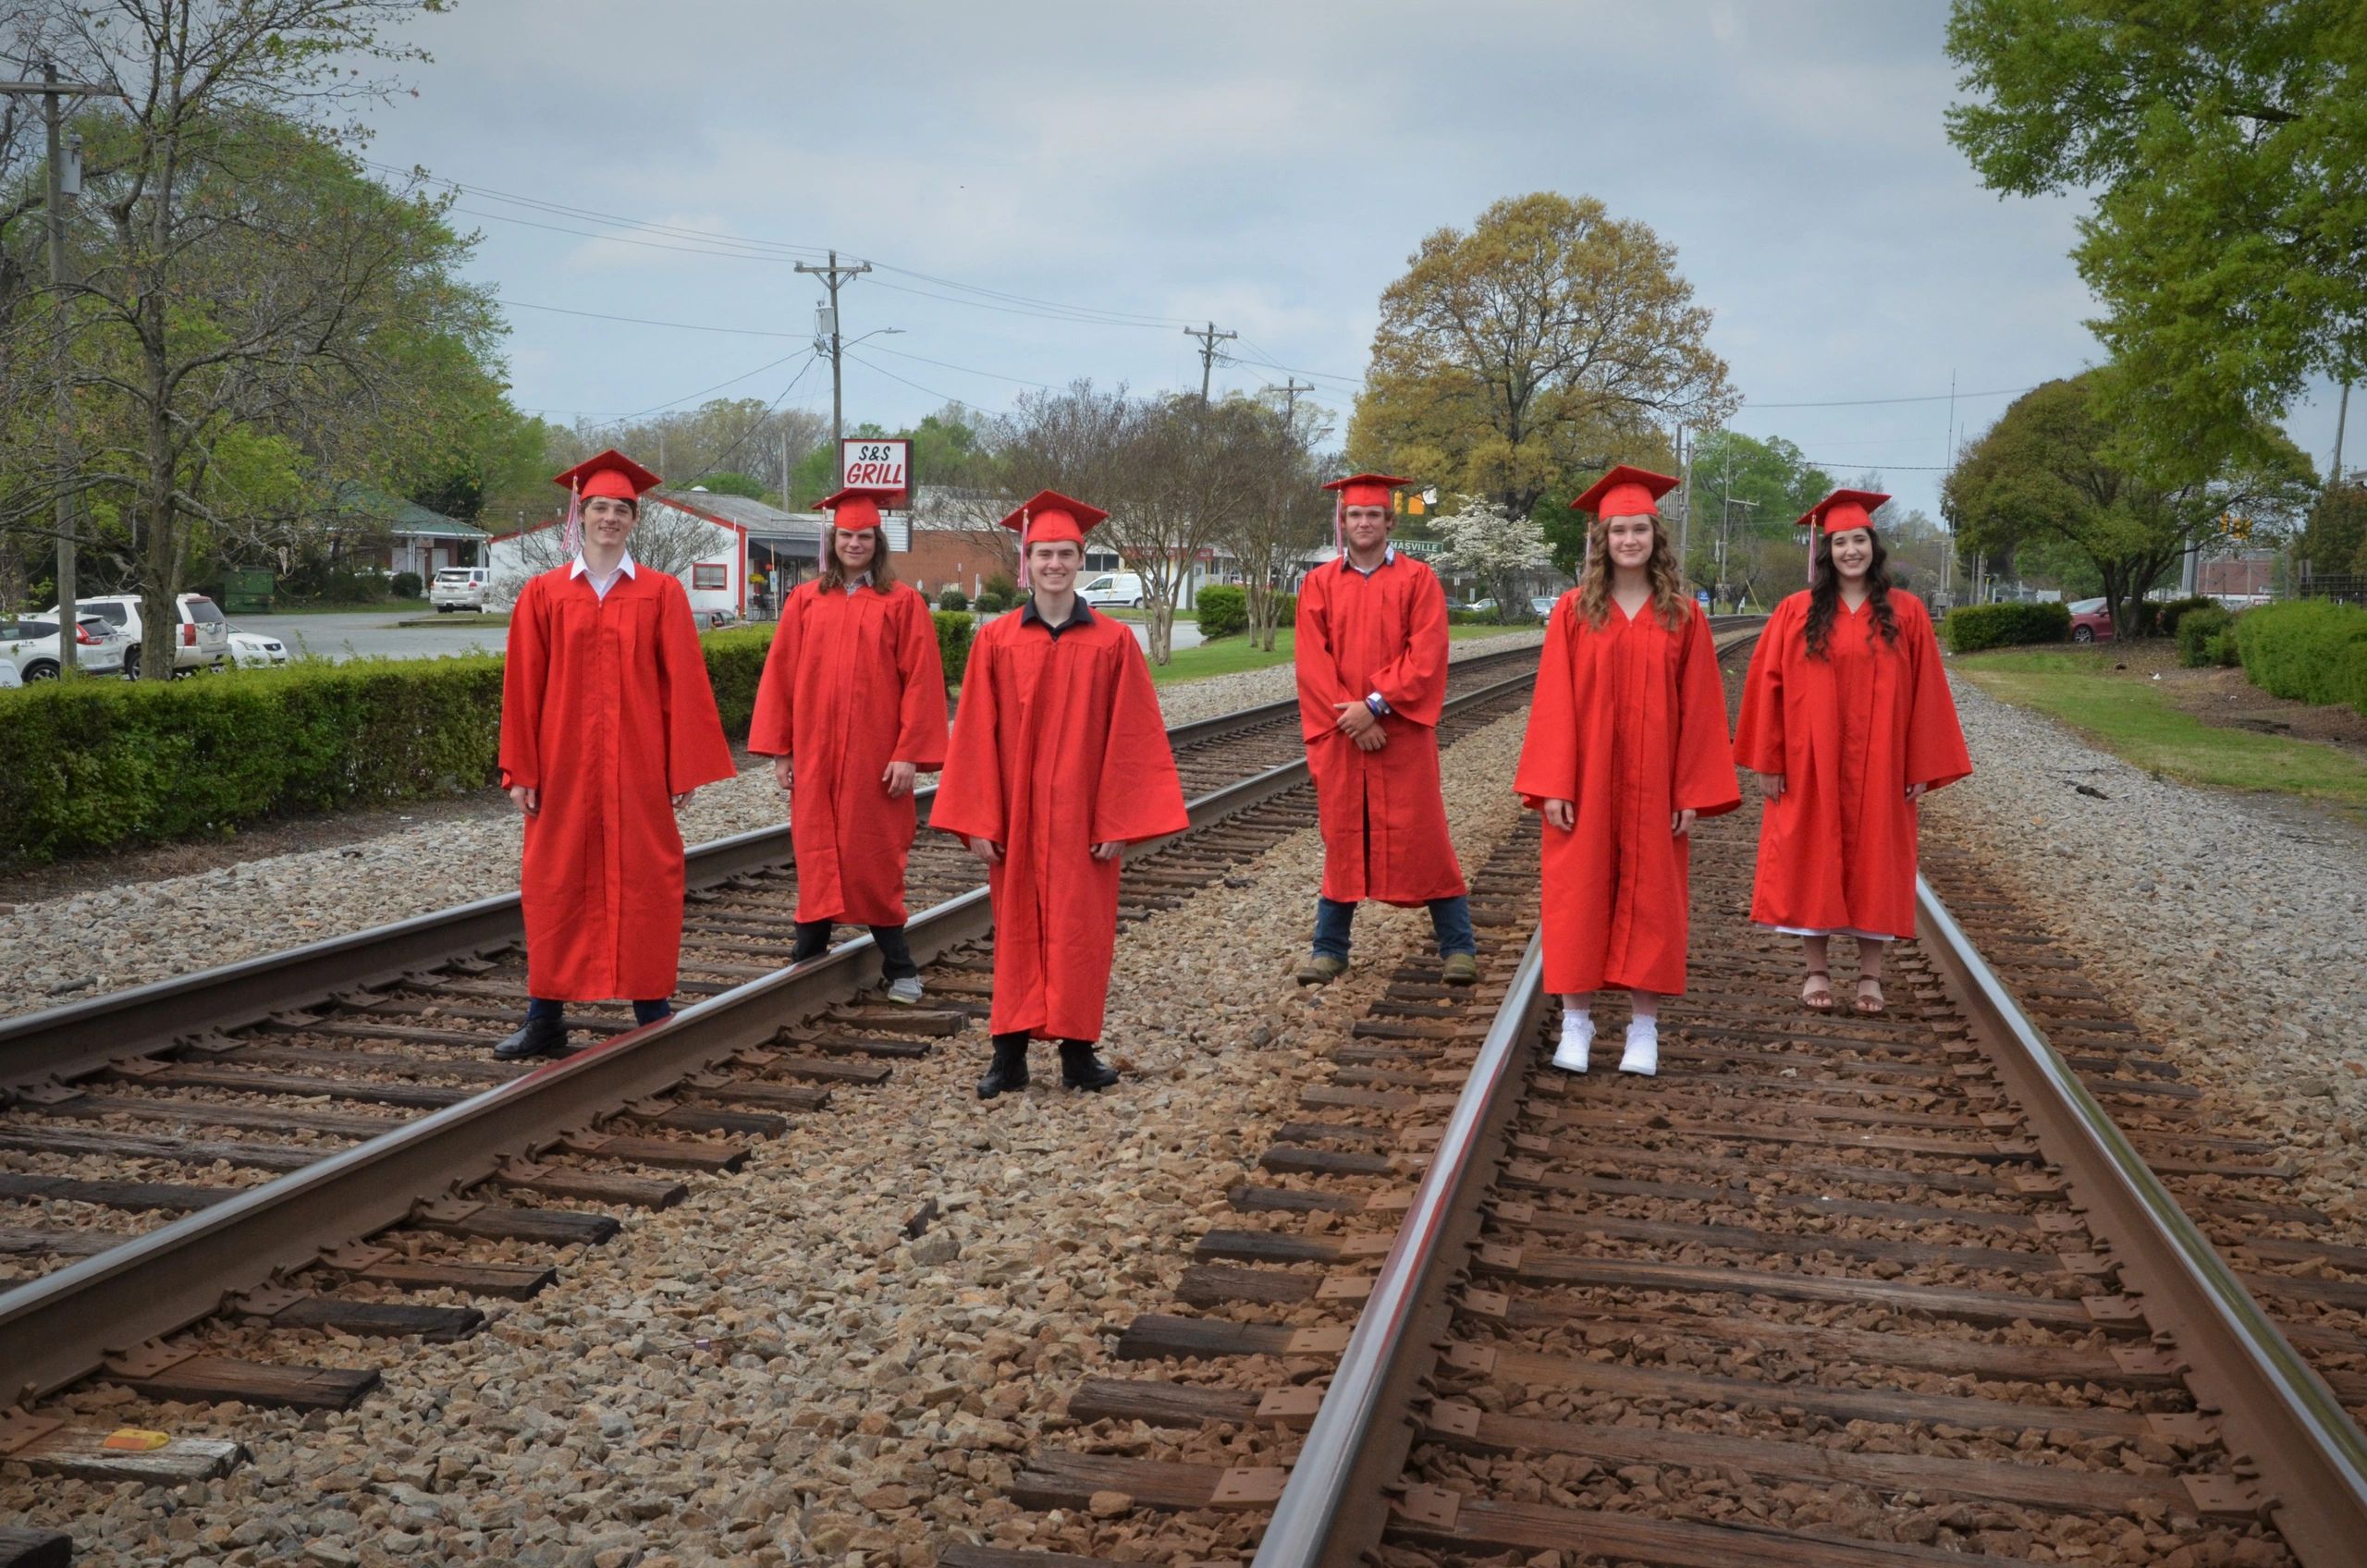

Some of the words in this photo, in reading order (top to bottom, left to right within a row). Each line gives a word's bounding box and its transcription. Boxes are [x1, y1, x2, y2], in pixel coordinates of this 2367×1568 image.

[859, 446, 890, 460] S&S
[847, 463, 902, 484] GRILL
[1390, 541, 1438, 552] MASVILLE
